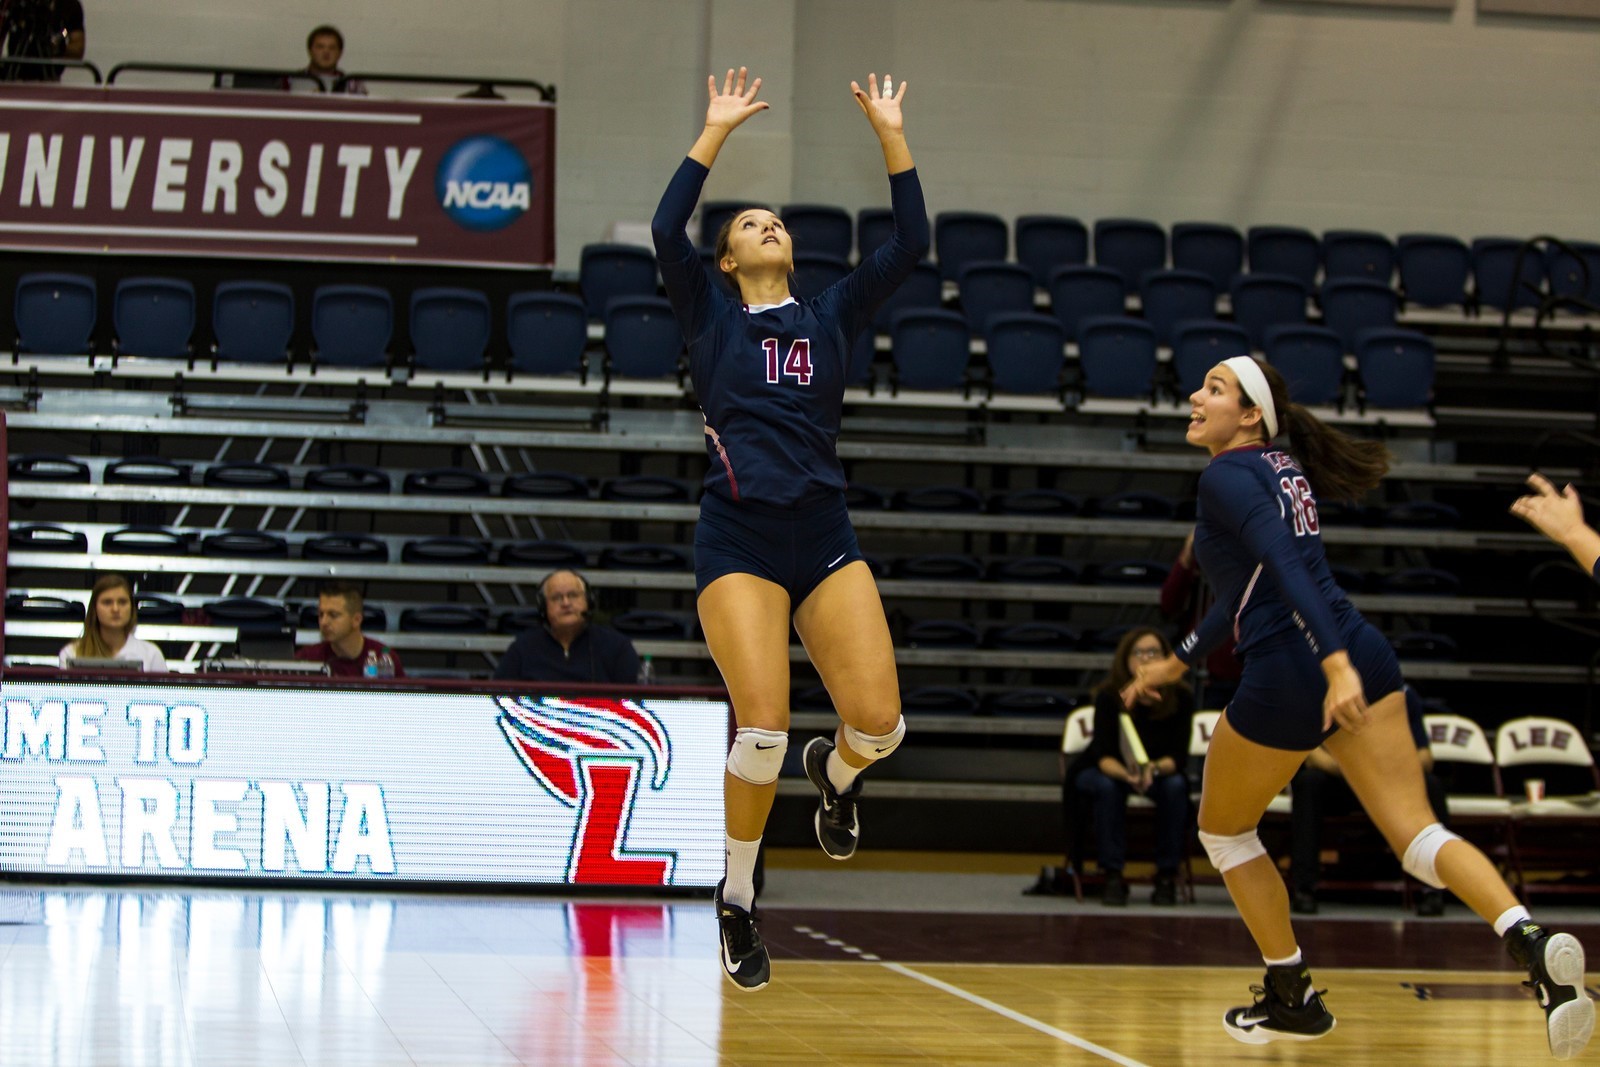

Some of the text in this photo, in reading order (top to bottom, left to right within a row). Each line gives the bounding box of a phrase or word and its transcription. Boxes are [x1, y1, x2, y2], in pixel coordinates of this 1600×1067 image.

[443, 180, 530, 210] NCAA
[762, 338, 813, 385] 14
[1280, 476, 1319, 536] 16
[126, 700, 209, 767] TO
[1430, 723, 1475, 749] EE
[1508, 726, 1572, 751] LEE
[43, 774, 398, 875] ARENA
